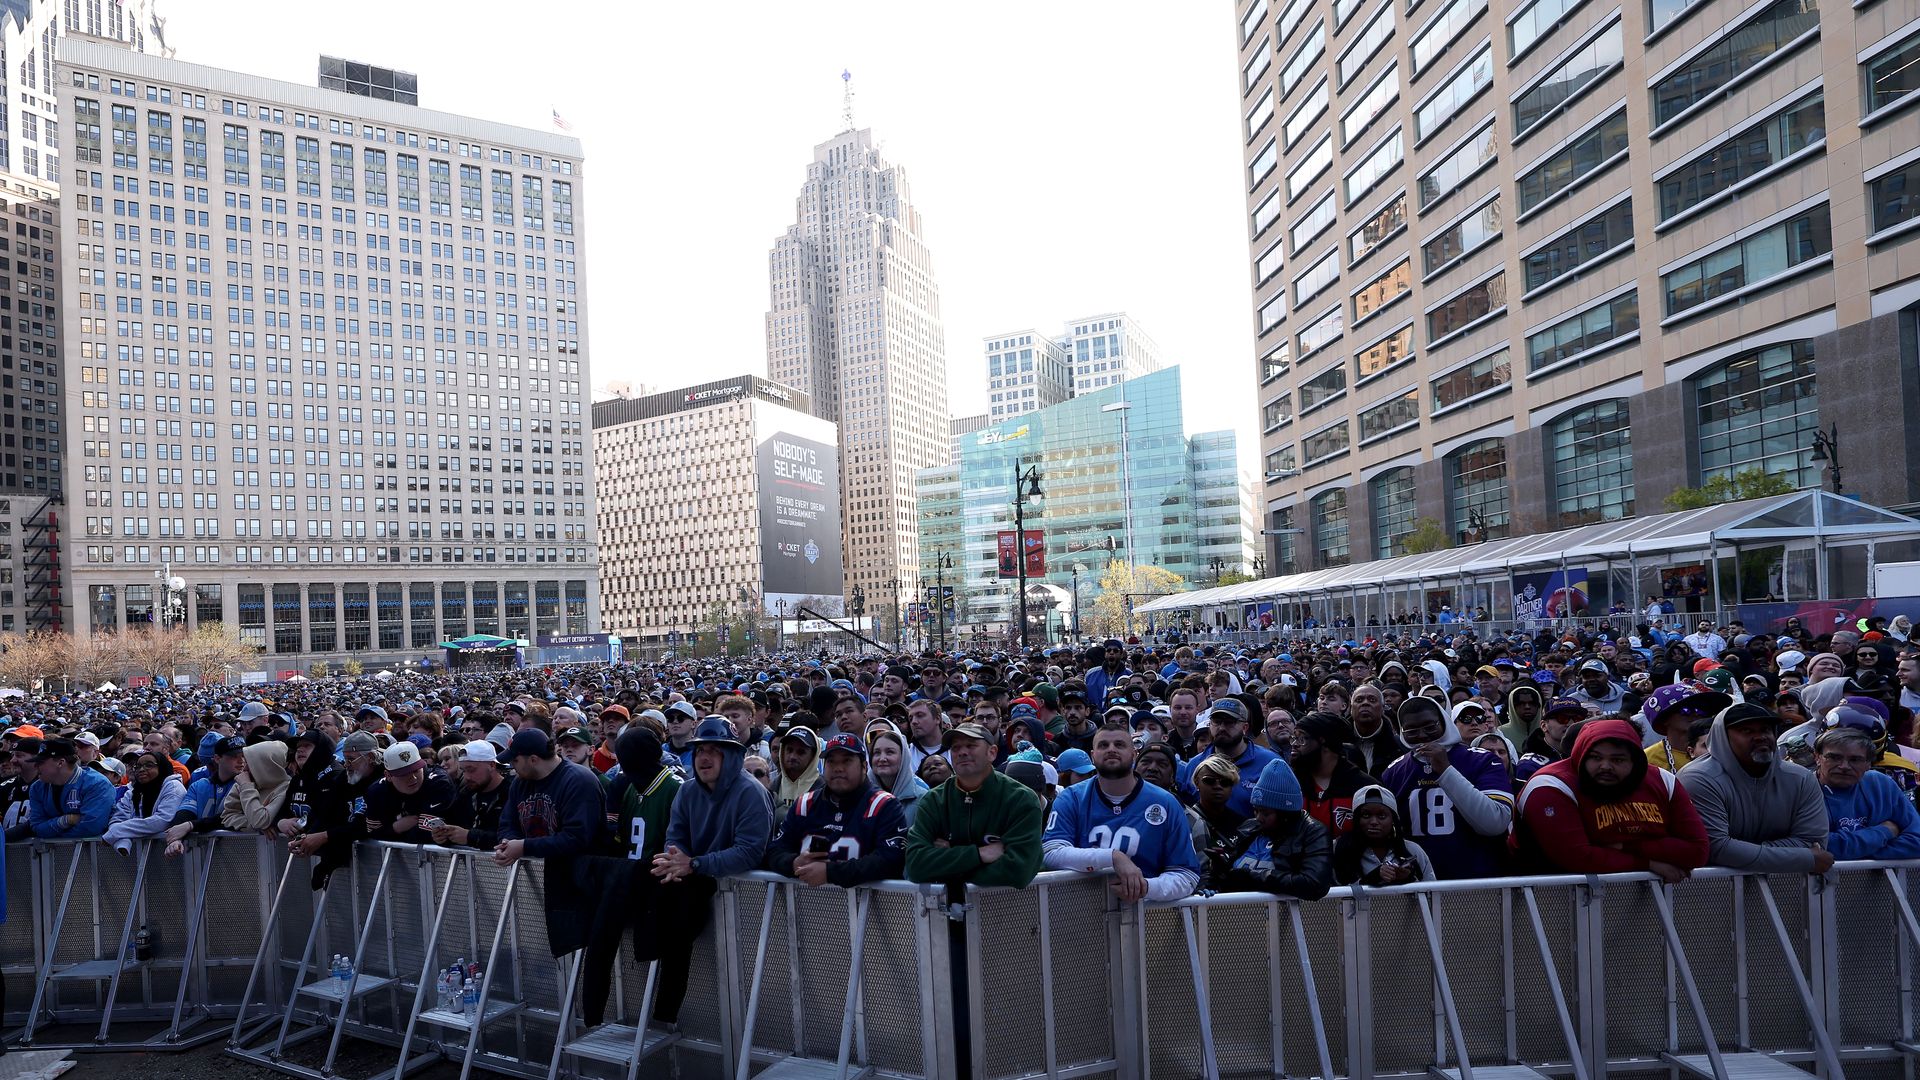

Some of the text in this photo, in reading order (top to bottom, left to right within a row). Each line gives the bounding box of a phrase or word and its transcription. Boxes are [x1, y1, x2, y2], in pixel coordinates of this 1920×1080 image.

[685, 386, 742, 402] ROCKET Mortgage
[773, 439, 816, 466] NOBODY'S
[774, 459, 826, 486] SELF-MADE.
[775, 495, 826, 513] BEHIND EVERY DREAM
[1514, 593, 1525, 606] NFL
[1516, 597, 1543, 617] PARTNER
[1408, 787, 1456, 837] 18
[627, 816, 646, 861] 9
